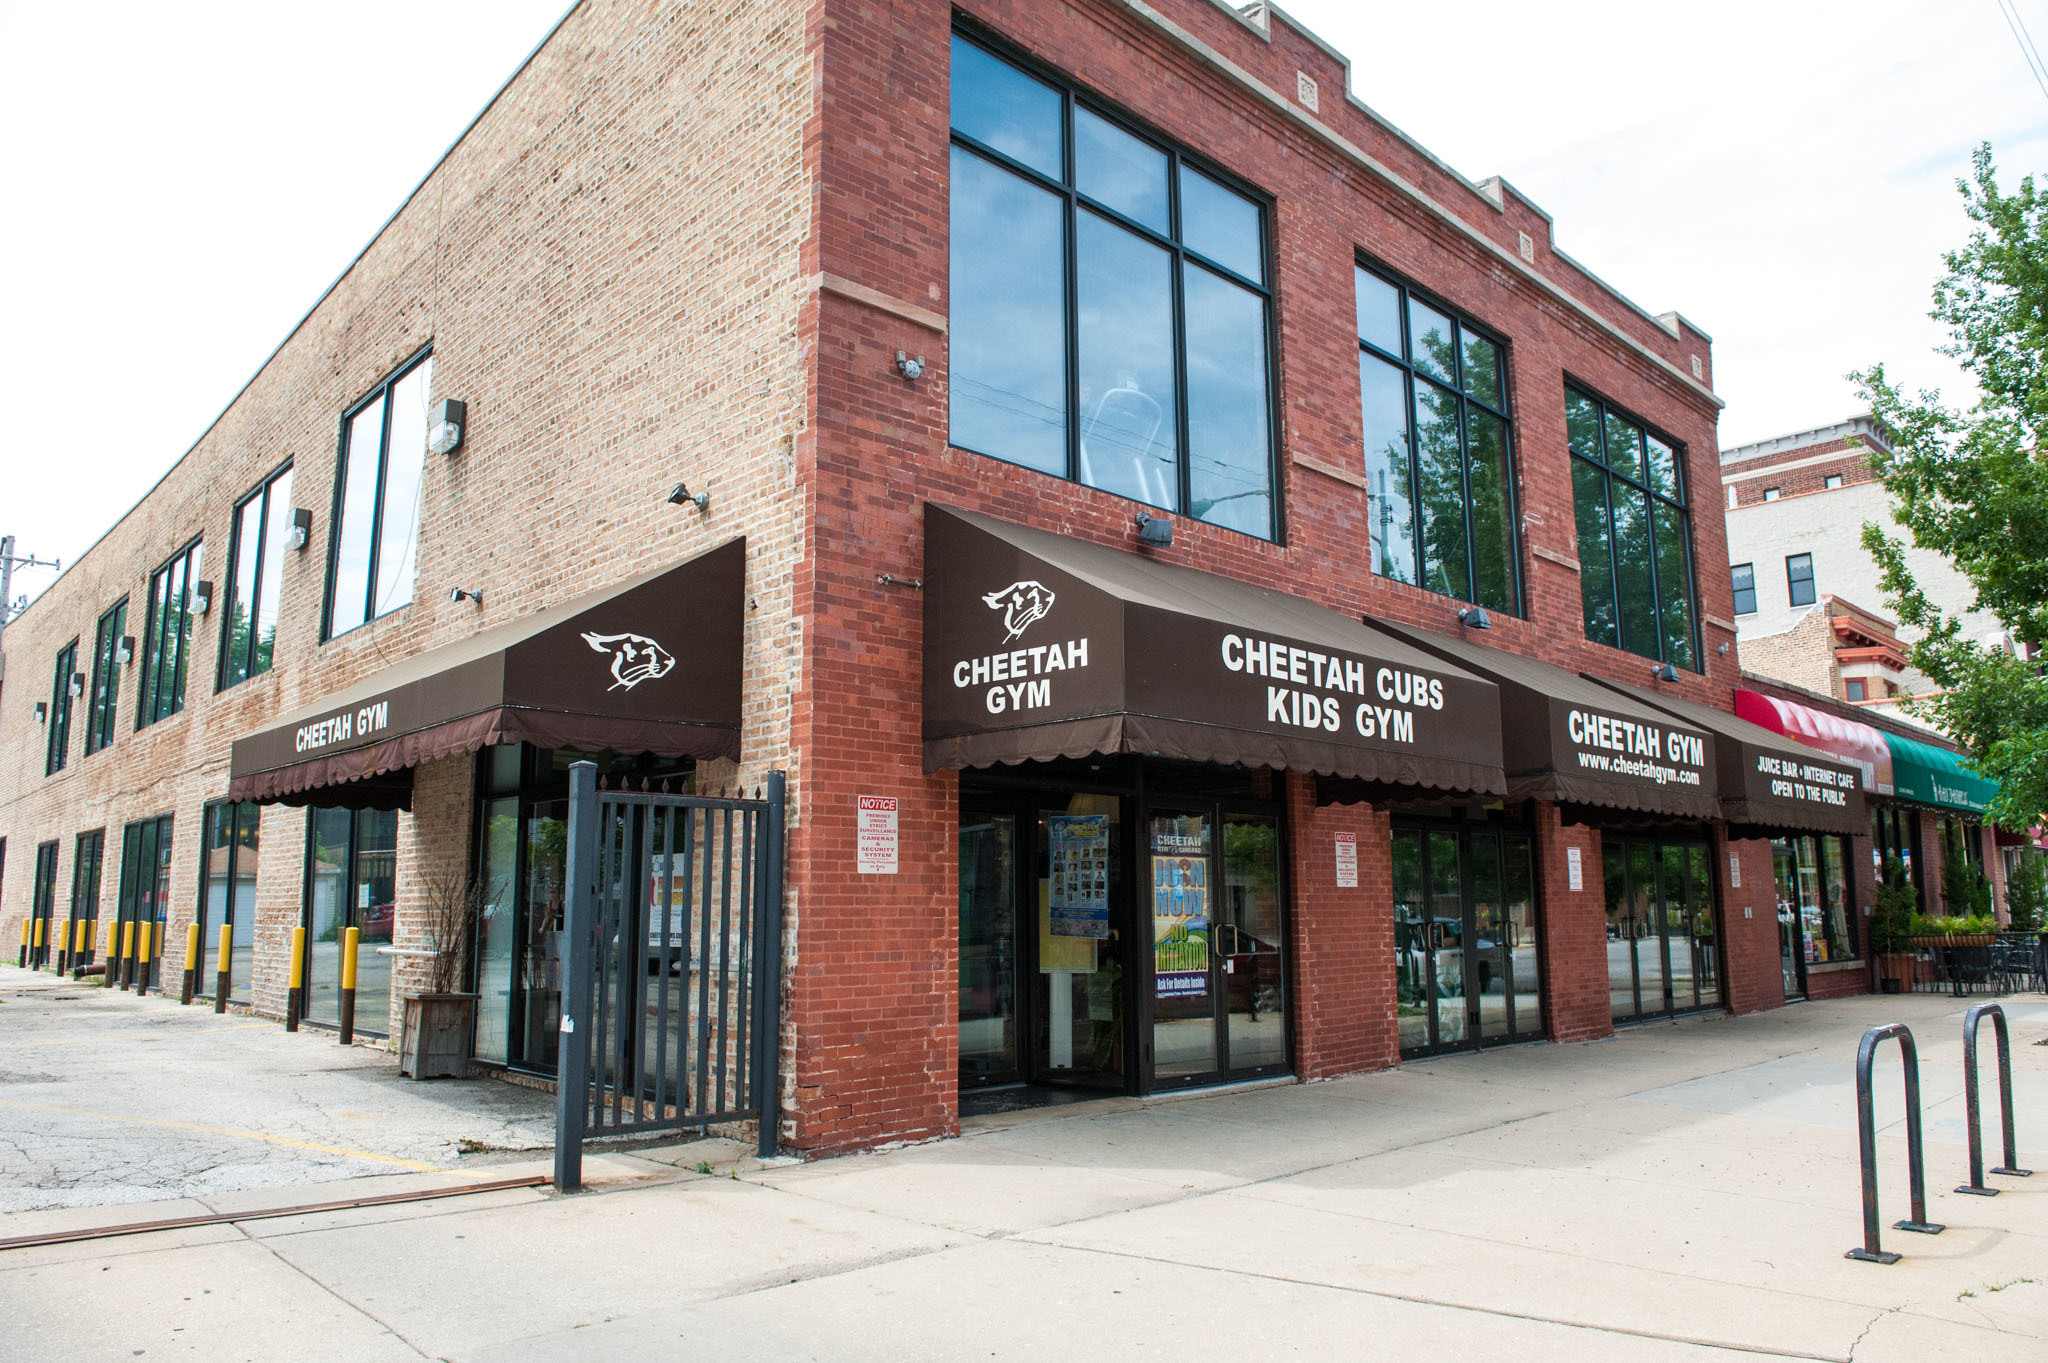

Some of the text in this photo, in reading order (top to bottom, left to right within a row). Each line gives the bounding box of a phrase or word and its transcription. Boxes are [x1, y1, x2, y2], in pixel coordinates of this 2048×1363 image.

[953, 637, 1088, 688] CHEETAH
[1221, 634, 1444, 711] CHEETAH CUBS
[986, 678, 1051, 714] GYM
[296, 700, 389, 753] CHEETAH GYM
[1267, 686, 1414, 744] KIDS GYM
[1568, 710, 1704, 767] CHEETAH GYM
[1577, 751, 1700, 785] www.cheetahgym.com
[1757, 755, 1781, 775] JUICE
[1781, 760, 1798, 778] BAR
[1803, 764, 1837, 786] INTERNET
[1837, 772, 1855, 789] CAFE
[860, 798, 896, 810] NOTICE
[1771, 779, 1846, 806] OPEN TO THE PUBLIC
[1157, 834, 1202, 847] CHEETAH
[1155, 888, 1204, 917] NOW
[1170, 924, 1189, 943] NO
[1157, 942, 1207, 972] INITIATION
[1157, 976, 1206, 990] Ask For Details Inside
